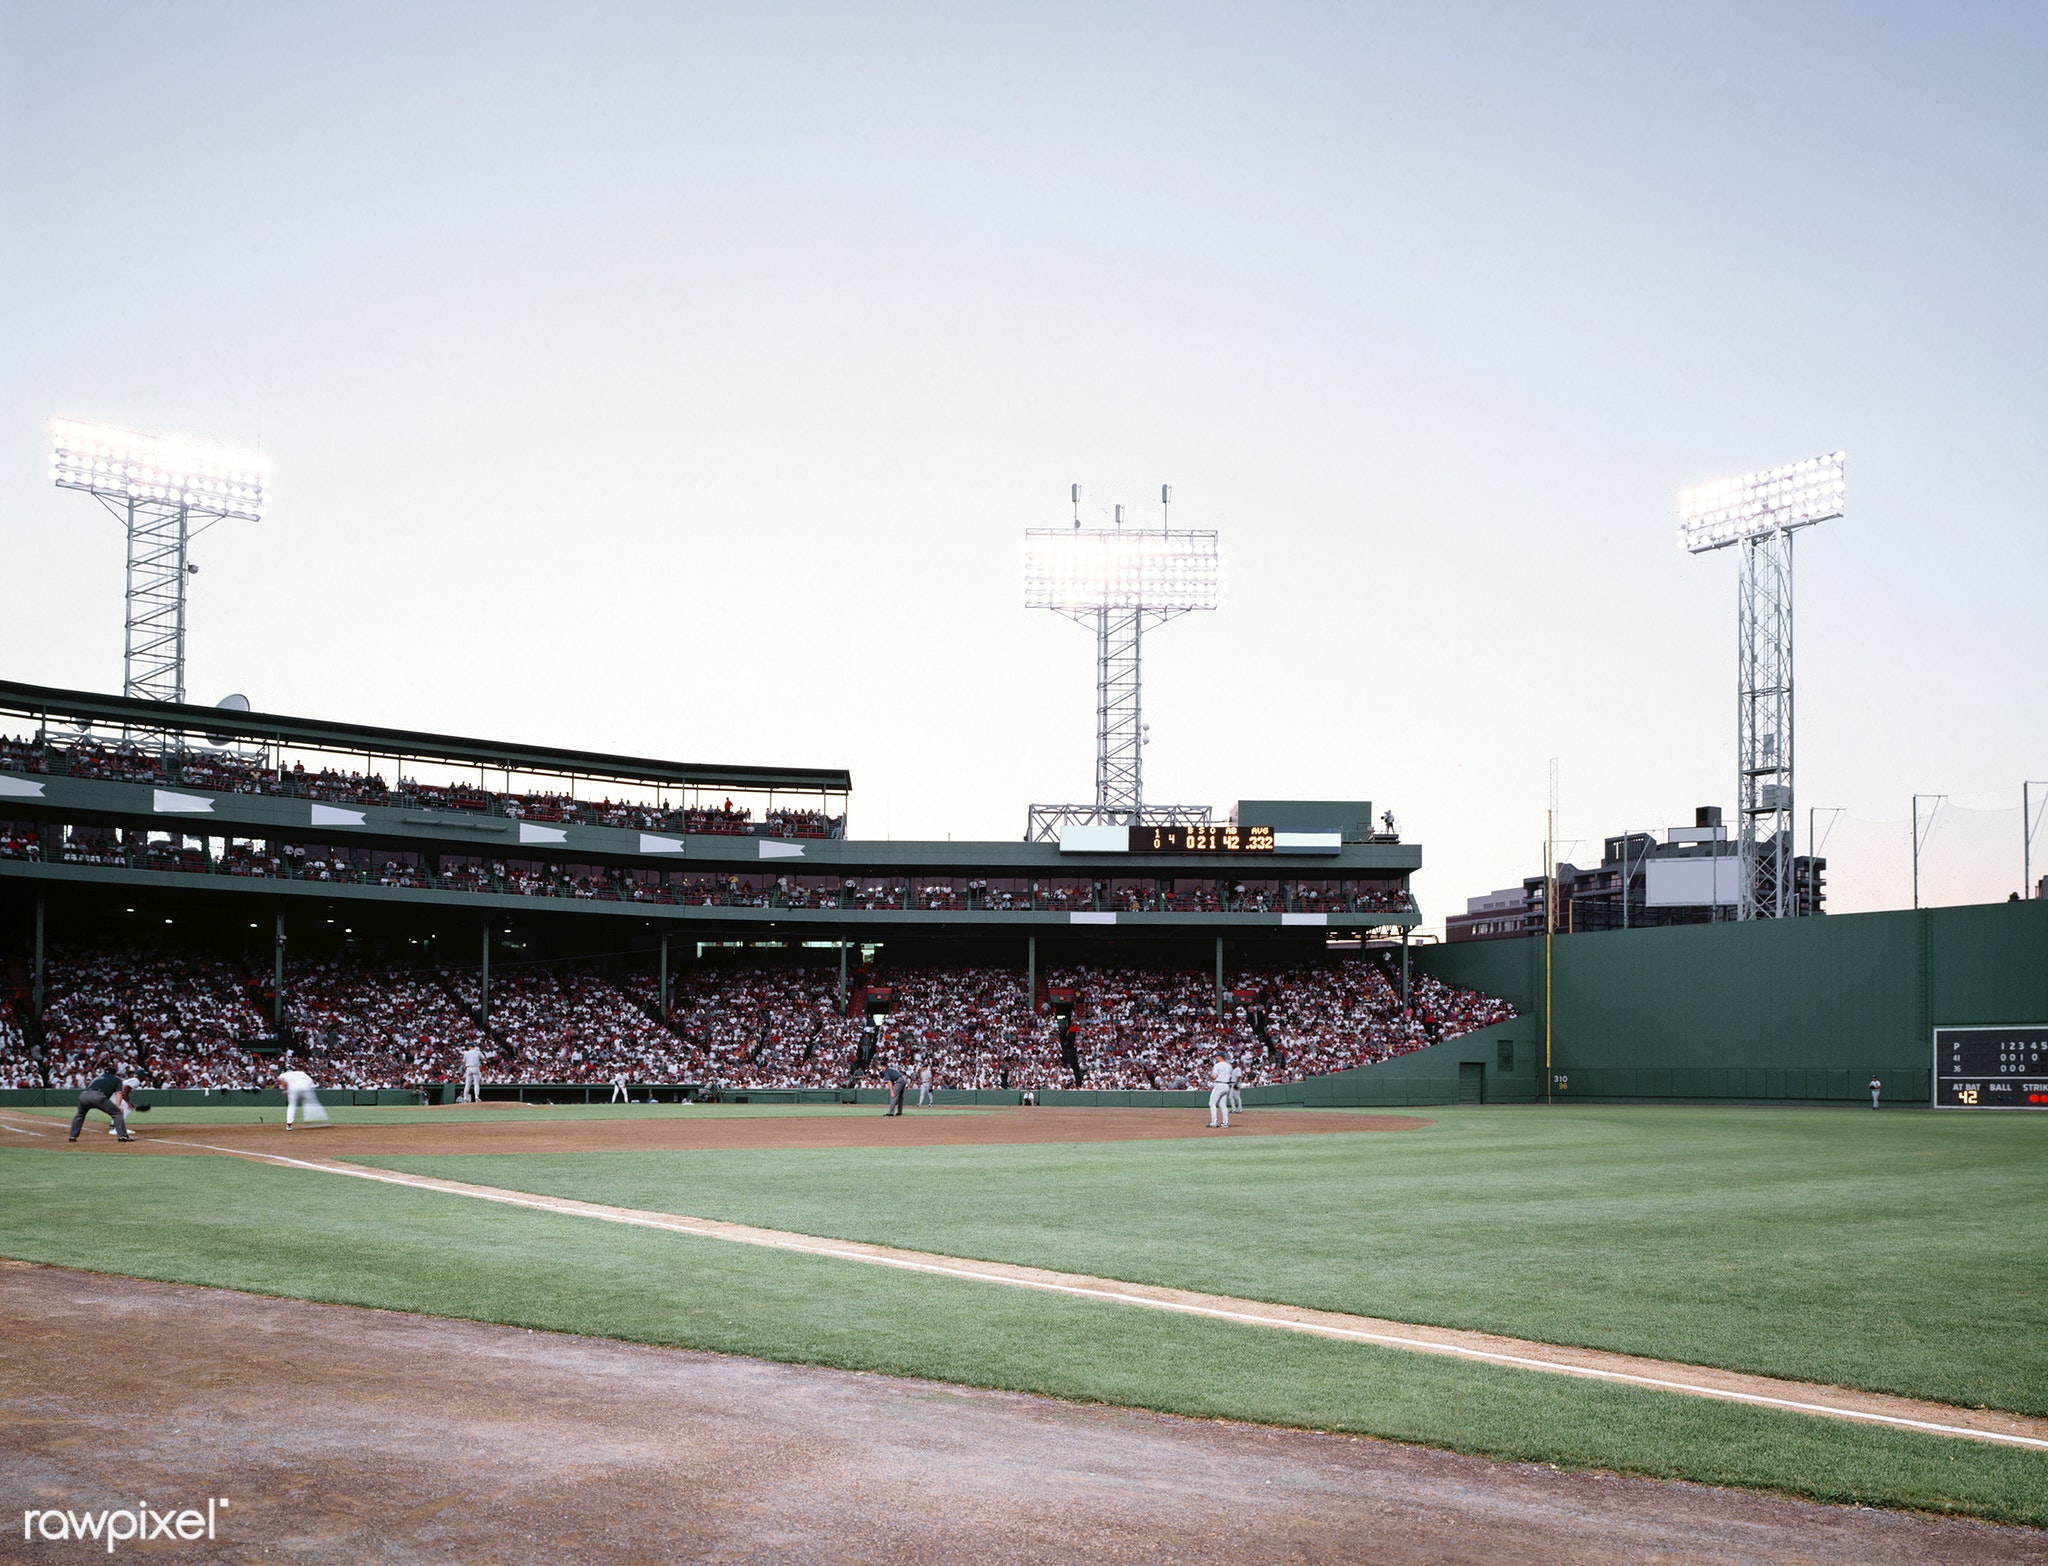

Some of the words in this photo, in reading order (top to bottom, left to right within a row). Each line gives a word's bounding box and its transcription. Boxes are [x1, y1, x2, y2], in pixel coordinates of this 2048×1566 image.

[1155, 829, 1160, 838] 1
[1168, 834, 1175, 844] 4
[1197, 836, 1206, 849] 2
[1209, 836, 1216, 849] 1
[1222, 836, 1240, 849] 42
[1245, 836, 1273, 849] .332
[1154, 839, 1160, 848] 0
[1953, 1042, 1960, 1050] P
[2001, 1042, 2005, 1050] 1
[2009, 1042, 2016, 1050] 2
[2018, 1042, 2025, 1050] 3
[2030, 1042, 2038, 1050] 4
[2000, 1053, 2007, 1061] 0
[2009, 1053, 2016, 1061] 0
[2031, 1053, 2038, 1061] 0
[2000, 1064, 2007, 1072] 0
[2009, 1064, 2016, 1072] 0
[2018, 1064, 2025, 1072] 0
[1553, 1075, 1568, 1083] 310
[1952, 1083, 1963, 1091] AT
[1965, 1083, 1981, 1091] BAT
[1989, 1083, 2012, 1091] BALL
[1958, 1090, 1978, 1104] 42
